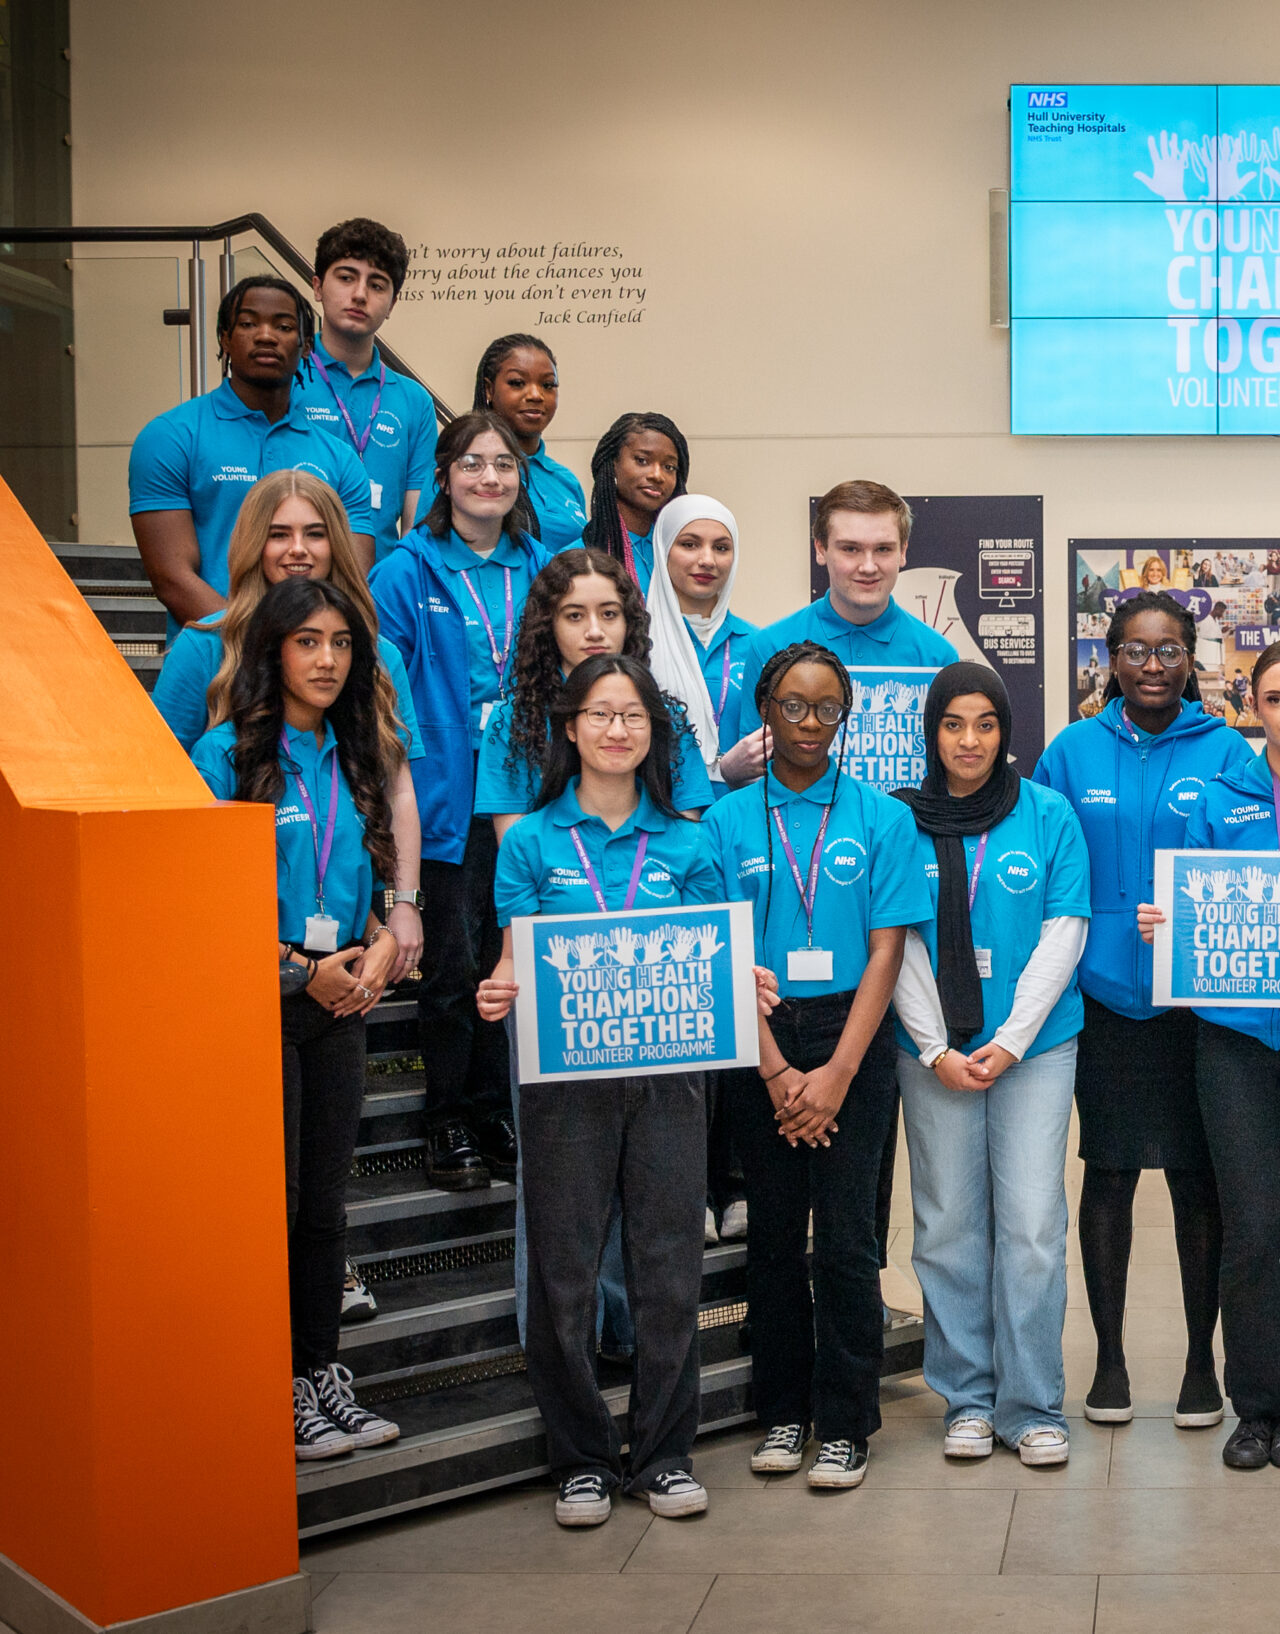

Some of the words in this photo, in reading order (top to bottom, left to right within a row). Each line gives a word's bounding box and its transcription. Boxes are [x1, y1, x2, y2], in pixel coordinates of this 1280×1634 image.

[1028, 92, 1067, 107] NHS
[1027, 112, 1049, 121] Hull
[1051, 112, 1106, 123] University
[1028, 123, 1074, 135] Teaching
[1077, 123, 1126, 135] Hospitals
[407, 243, 429, 259] n't
[436, 247, 490, 263] worry
[497, 243, 546, 259] about
[548, 242, 623, 263] failures,
[405, 269, 441, 285] orry
[447, 264, 496, 280] about
[503, 263, 530, 279] the
[536, 263, 604, 279] chances
[610, 267, 642, 284] you
[432, 285, 477, 301] when
[483, 289, 515, 305] you
[521, 284, 565, 300] don't
[571, 288, 613, 300] even
[618, 287, 647, 304] try
[534, 310, 572, 326] Jack
[576, 308, 646, 328] Canfield
[376, 423, 395, 435] NHS
[221, 466, 248, 474] YOUNG
[212, 474, 258, 482] VOLUNTEER
[978, 539, 994, 549] FIND
[995, 539, 1012, 549] YOUR
[1013, 539, 1034, 549] ROUTE
[984, 638, 999, 650] BUS
[1000, 638, 1035, 650] SERVICES
[1240, 630, 1260, 646] THE
[828, 733, 927, 757] AMPIONS
[1178, 792, 1199, 801] NHS
[275, 805, 299, 817] OUNG
[1231, 804, 1260, 815] YOUNG
[1223, 811, 1271, 824] VOLUNTEER
[740, 856, 766, 868] YOUNG
[834, 855, 857, 866] NHS
[552, 868, 580, 877] YOUNG
[648, 871, 671, 883] NHS
[736, 863, 776, 880] VOLUNTEER
[1007, 865, 1029, 877] NHS
[1194, 903, 1259, 924] YOUNG
[558, 968, 631, 993] YOUNG
[636, 961, 712, 988] HEALTH
[1193, 978, 1257, 994] VOLUNTEER
[560, 983, 714, 1020] CHAMPIONS
[561, 1011, 715, 1050] TOGETHER
[563, 1046, 633, 1066] VOLUNTEER
[640, 1040, 716, 1060] PROGRAMME
